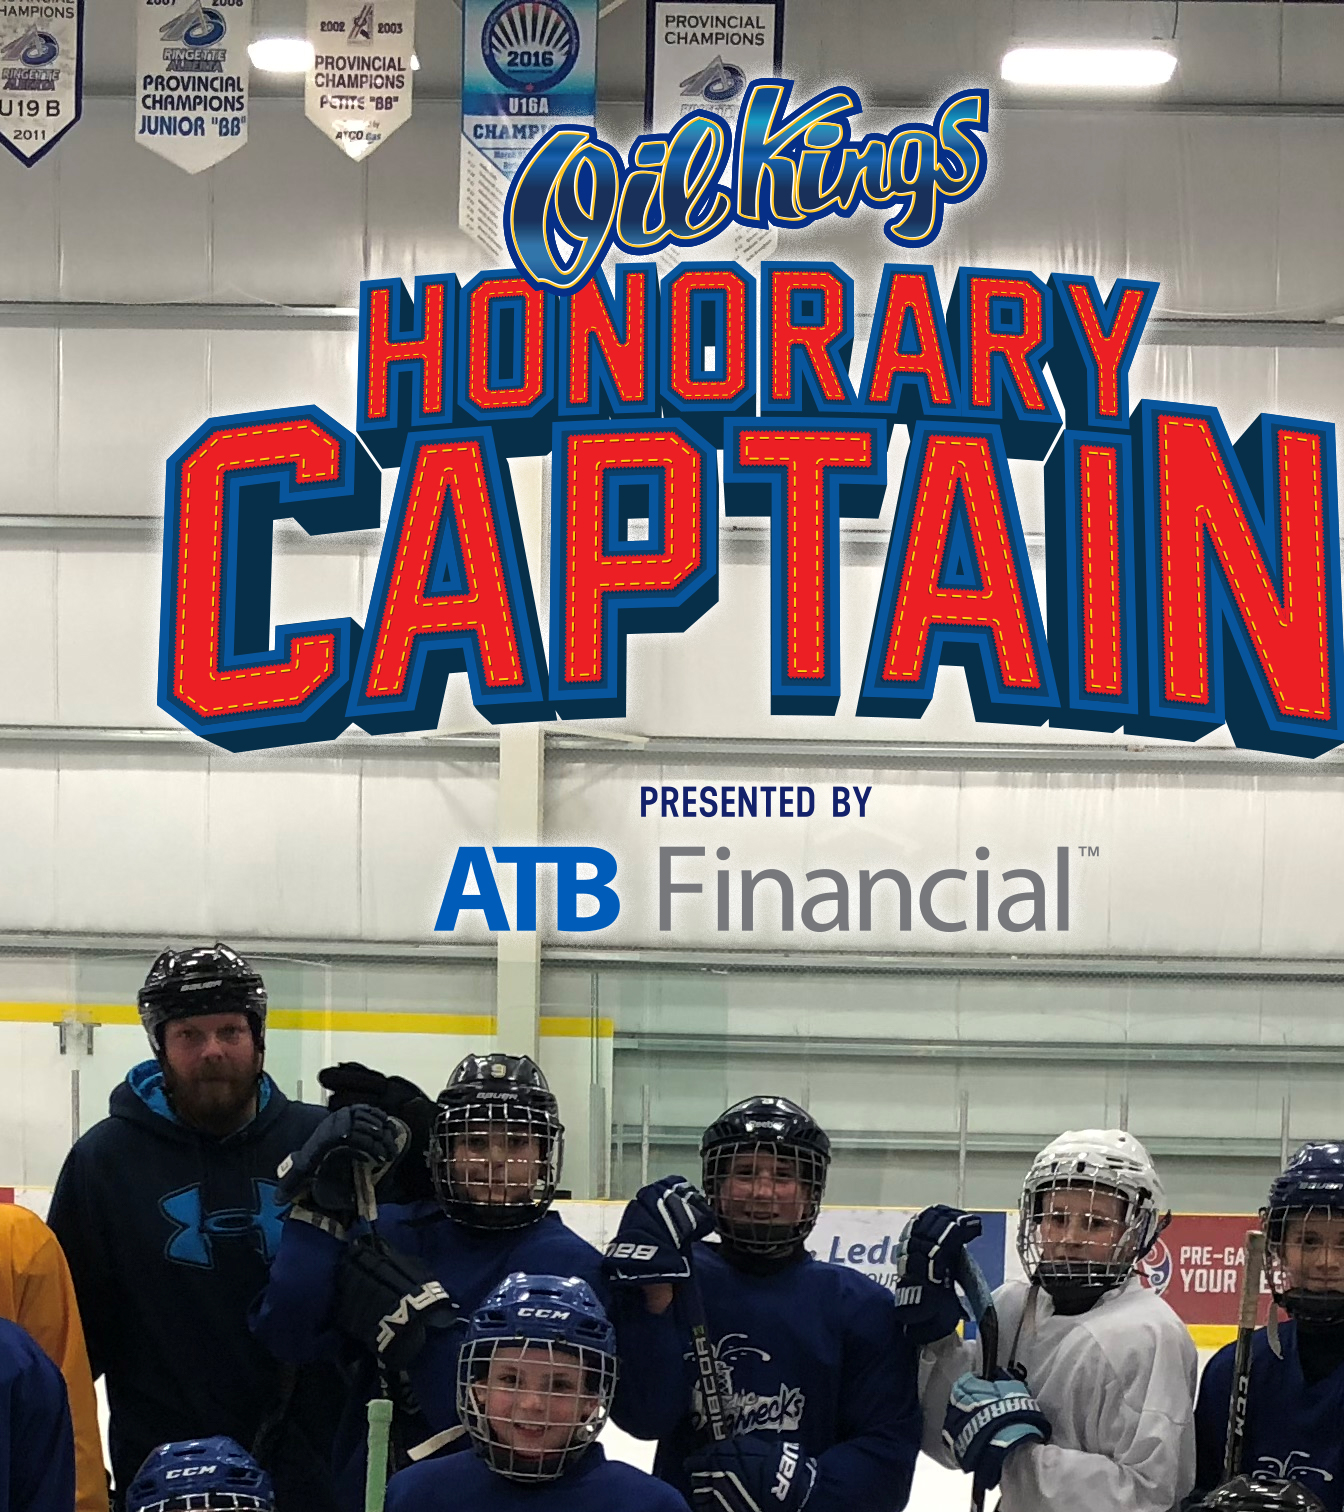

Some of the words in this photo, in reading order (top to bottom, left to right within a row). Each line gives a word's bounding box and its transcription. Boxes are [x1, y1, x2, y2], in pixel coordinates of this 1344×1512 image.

[320, 21, 346, 32] 2002
[378, 22, 404, 34] 2003
[665, 15, 766, 30] PROVINCIAL
[665, 31, 765, 46] CHAMPIONS
[163, 48, 227, 61] RINGETTE
[507, 50, 554, 67] 2016
[315, 55, 406, 72] PROVINCIAL
[1, 69, 61, 81] RINGETTE
[314, 72, 405, 90] CHAMPIONS
[142, 75, 244, 93] PROVINCIAL
[141, 94, 245, 112] CHAMPIONS
[508, 97, 550, 115] U16A
[138, 115, 206, 136] JUNIOR
[13, 129, 47, 141] 2011
[179, 980, 223, 992] BAUER
[490, 1063, 507, 1079] 9
[476, 1091, 519, 1102] BAUER
[1298, 1181, 1344, 1192] BAUER
[1180, 1245, 1246, 1267] PRE-GA
[1180, 1268, 1237, 1294] YOUR
[517, 1306, 570, 1321] CCM
[165, 1463, 218, 1480] CCM
